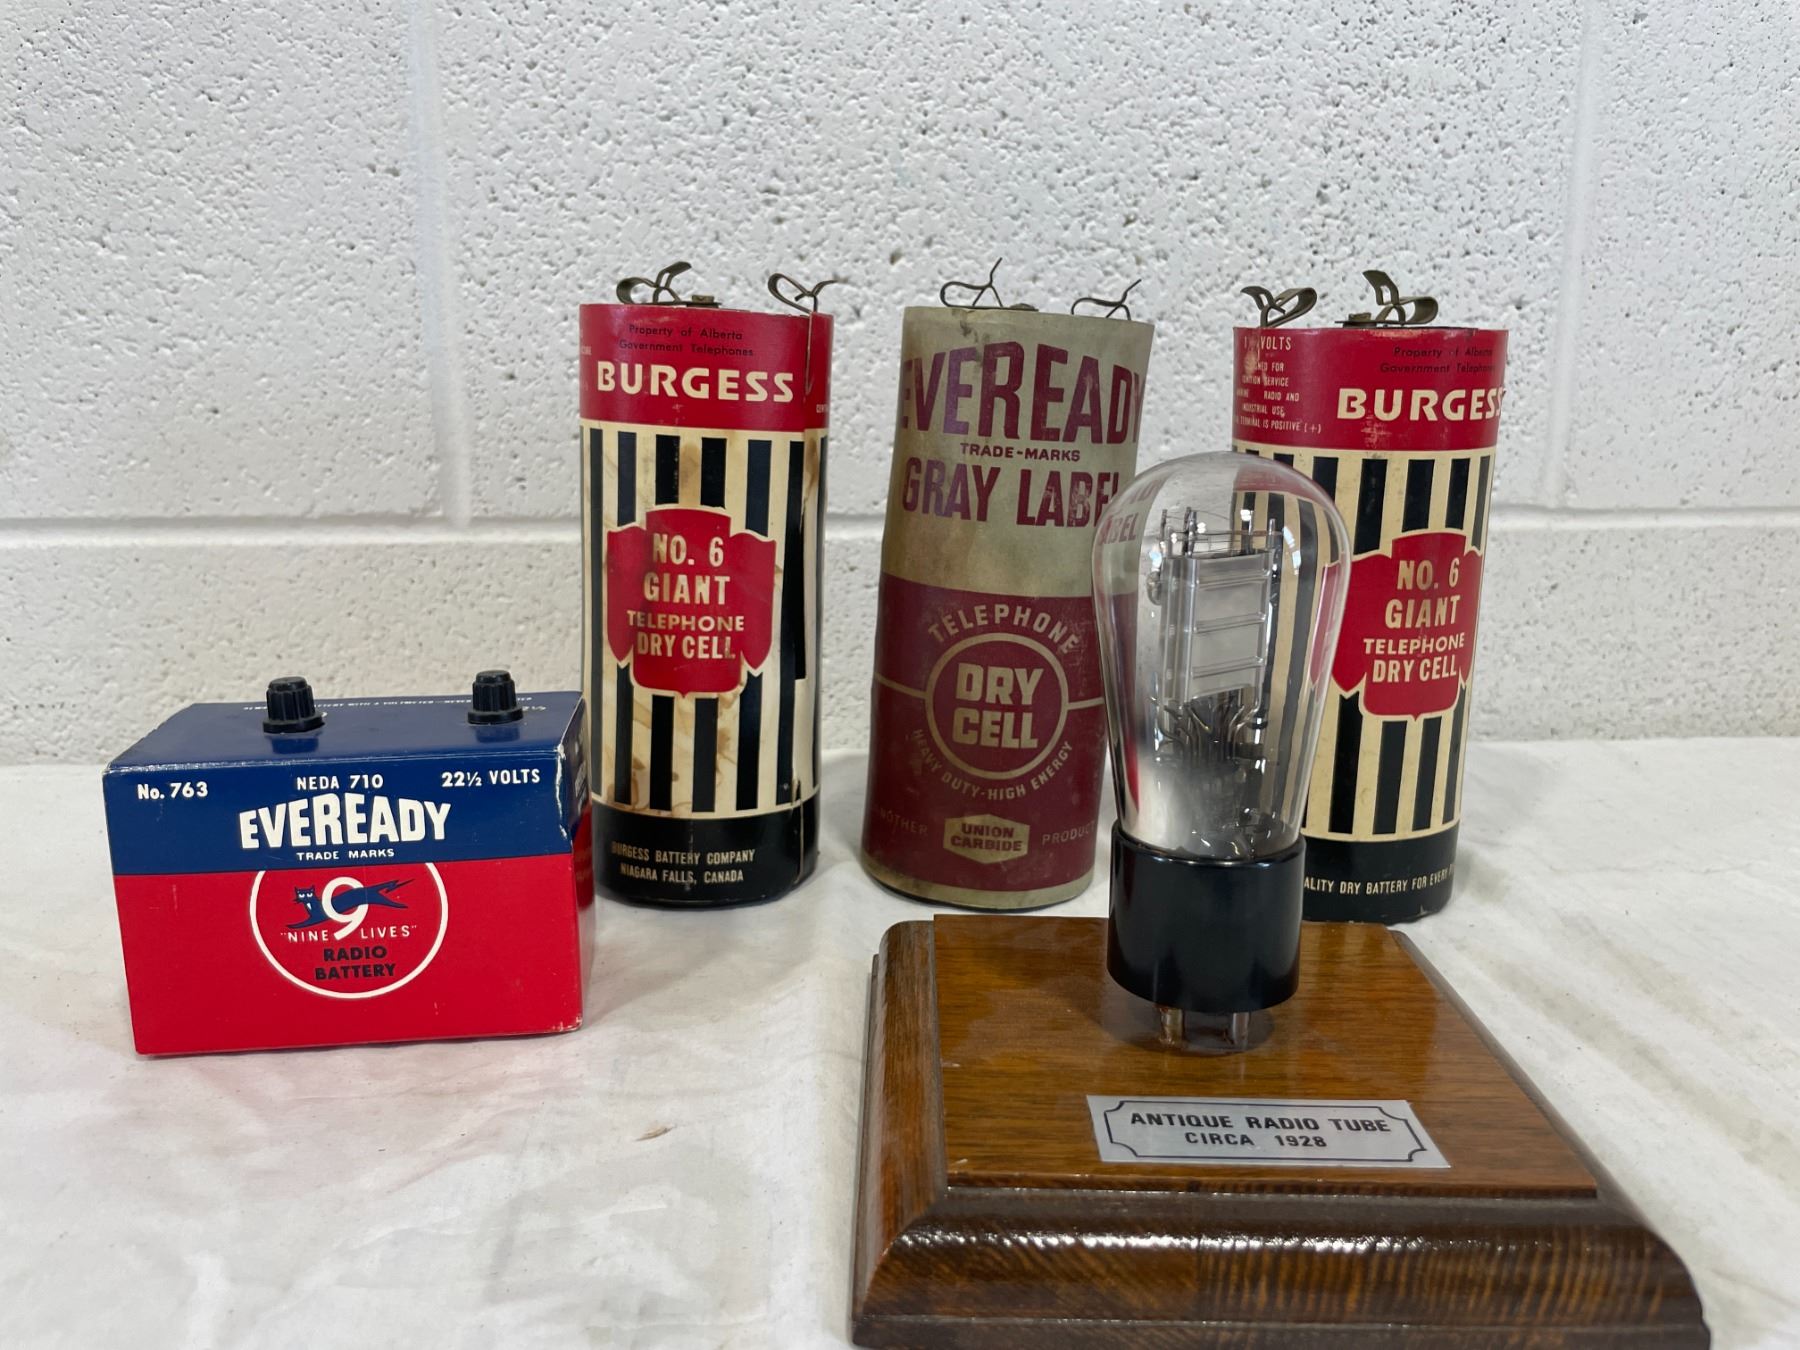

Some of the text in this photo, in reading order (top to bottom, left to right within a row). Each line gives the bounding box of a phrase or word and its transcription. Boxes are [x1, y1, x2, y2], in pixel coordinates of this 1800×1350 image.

[629, 324, 742, 340] Property of Alberta
[619, 339, 753, 356] Government Telephones
[1260, 336, 1292, 350] VOLTS
[1394, 346, 1442, 358] Property
[1272, 362, 1284, 372] FOR
[1380, 362, 1498, 374] Government Telephon
[597, 361, 794, 402] BURGESS
[1264, 377, 1288, 387] SERVICE
[1264, 390, 1300, 402] RADIO AND
[1270, 420, 1300, 430] POSITIVE
[960, 442, 1080, 462] TRADE-MARKS
[902, 457, 1001, 522] GRAY
[653, 532, 724, 566] NO. 6
[1397, 558, 1460, 590] NO. 6
[643, 573, 730, 606] GIANT
[626, 610, 745, 632] TELEPHONE
[1385, 595, 1460, 630] GIANT
[927, 603, 1081, 654] TELEPHONE
[637, 632, 736, 660] DRY CELL
[1363, 632, 1465, 654] TELEPHONE
[1372, 654, 1457, 682] DRY CELL
[956, 662, 1044, 705] DRY
[952, 707, 1039, 749] CELL
[913, 728, 943, 773] HEAVY
[1031, 741, 1074, 790] ENERGY
[297, 774, 384, 790] NEDA 710
[441, 768, 540, 788] 22½ VOLTS
[137, 782, 208, 800] No. 763
[239, 792, 451, 849] EVEREADY
[880, 808, 928, 834] NOTHER
[961, 823, 1015, 838] UNION
[297, 848, 395, 860] TRADE MARKS
[612, 840, 756, 865] BURGESS BATTERY COMPANY
[951, 836, 1022, 852] CARBIDE
[620, 862, 744, 884] NIAGARA FALLS, CANADA
[1304, 876, 1334, 893] ALITY
[1339, 881, 1362, 895] DRY
[1365, 880, 1408, 895] BATTERY
[1412, 874, 1427, 890] FOR
[1429, 868, 1449, 886] EVERY
[324, 946, 387, 961] RADIO
[315, 964, 396, 980] BATTERY
[1130, 1112, 1391, 1132] ANTIQUE RADIO TUBE
[1185, 1132, 1327, 1148] CIRCA 1928
